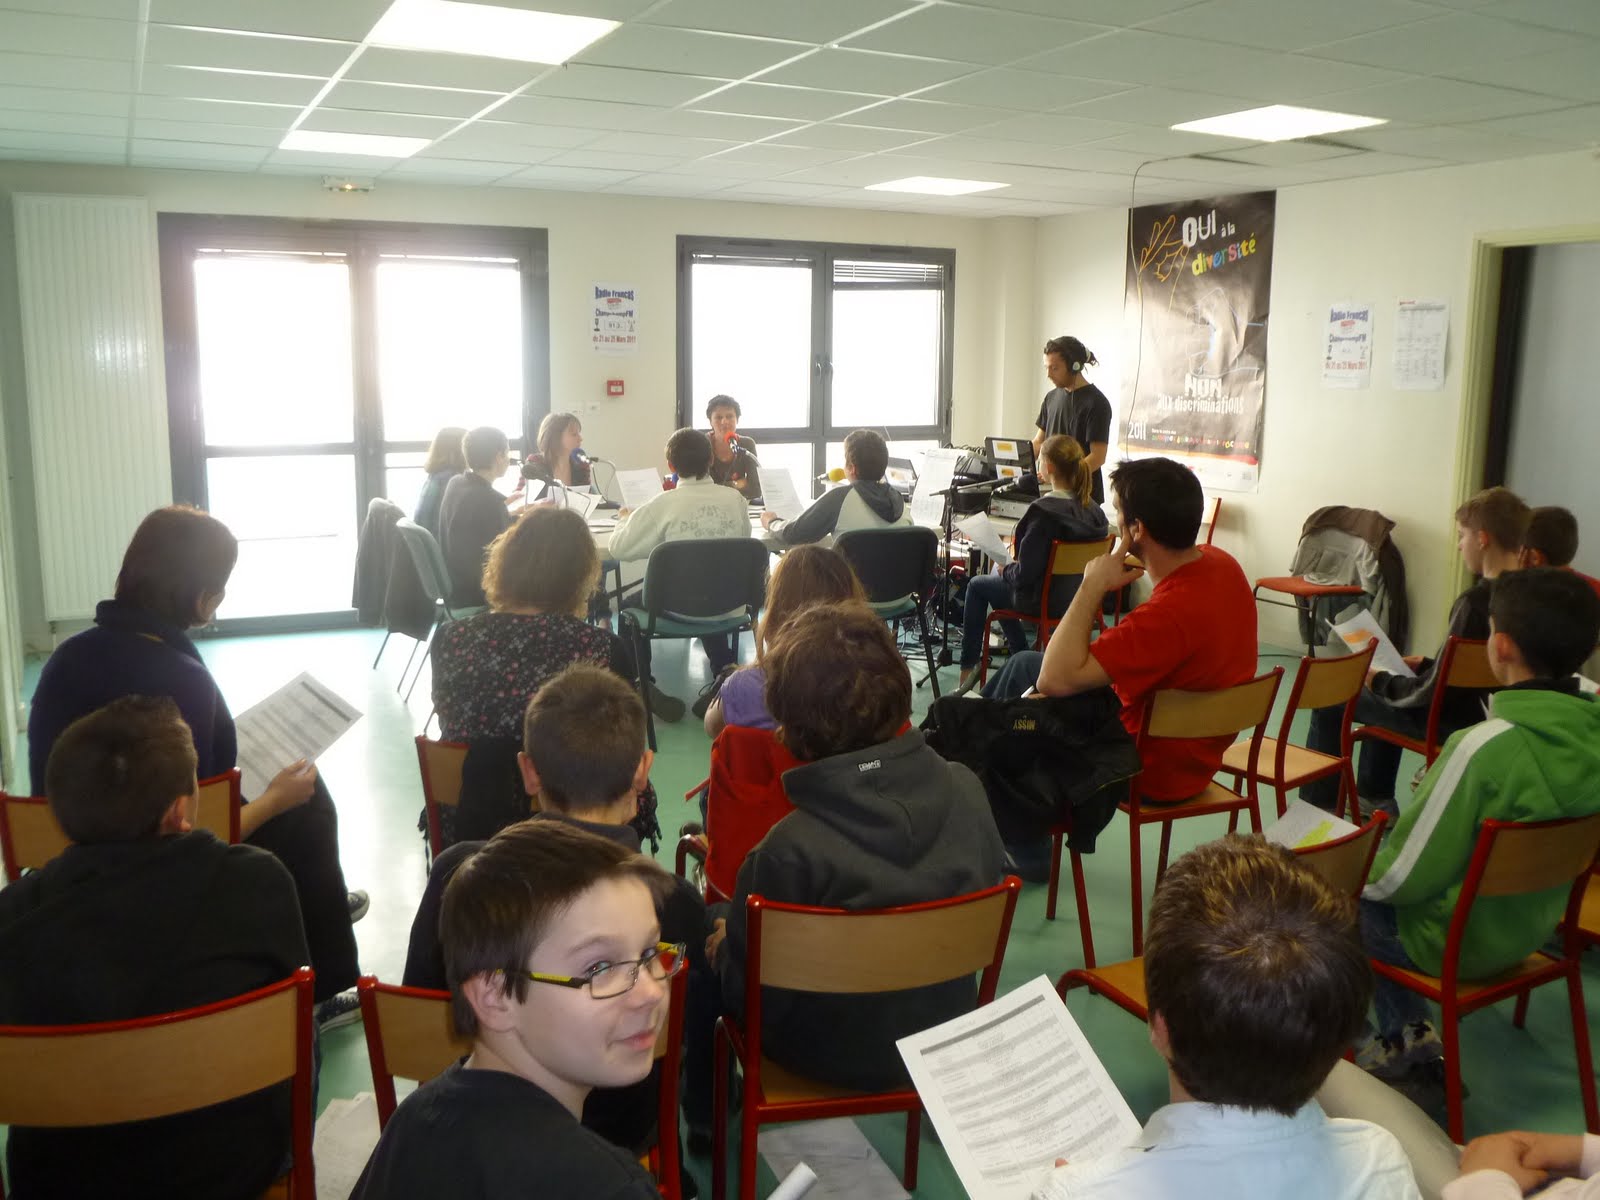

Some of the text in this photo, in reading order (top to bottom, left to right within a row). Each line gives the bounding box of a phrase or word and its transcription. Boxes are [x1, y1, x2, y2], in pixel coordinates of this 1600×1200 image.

[1182, 209, 1236, 248] OUI à la
[1191, 232, 1256, 276] diversité
[595, 286, 611, 300] Radio
[616, 335, 626, 343] Mars
[1185, 373, 1222, 398] NON
[1127, 421, 1147, 441] 2011
